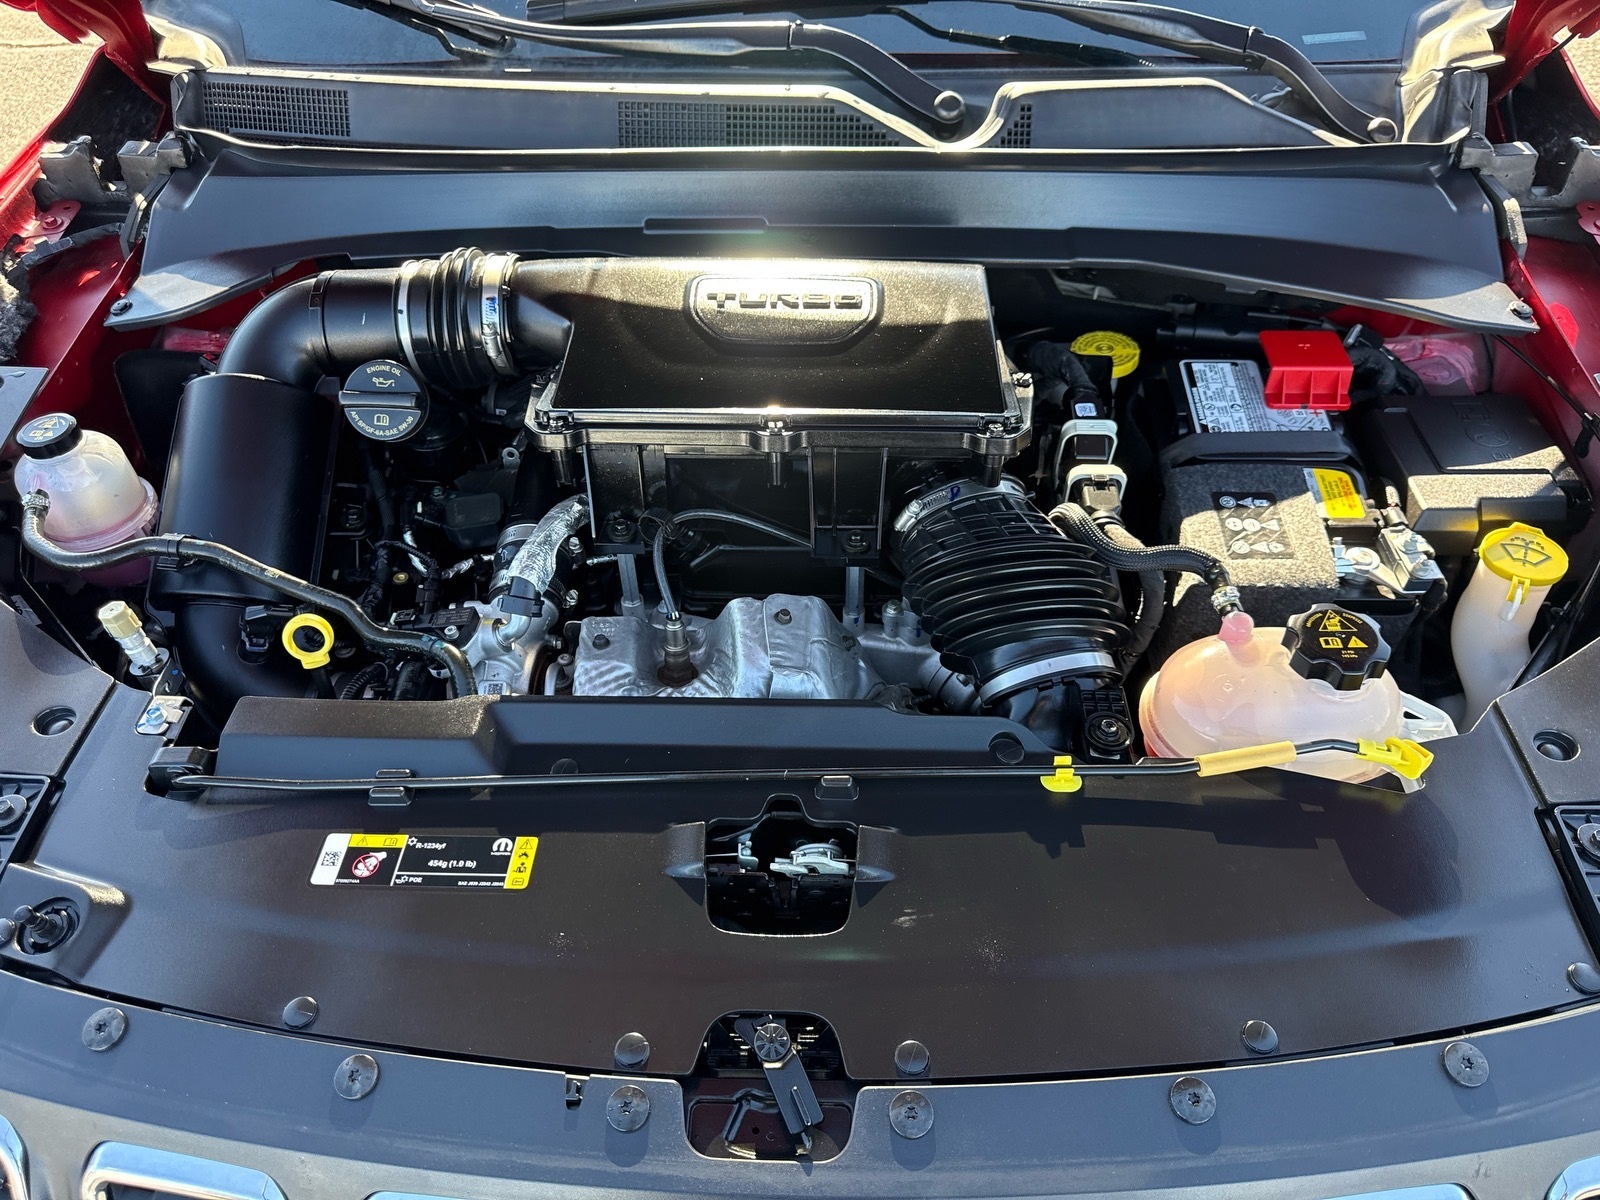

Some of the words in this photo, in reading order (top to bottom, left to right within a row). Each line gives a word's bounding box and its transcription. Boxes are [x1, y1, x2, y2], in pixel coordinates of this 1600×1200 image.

[706, 292, 863, 312] TURBO
[366, 365, 390, 374] ENGINE
[391, 367, 401, 377] OIL
[350, 411, 360, 422] API
[398, 415, 414, 430] 5W-30
[427, 859, 448, 869] 454g
[448, 859, 464, 869] (1.0
[465, 860, 477, 869] lb)
